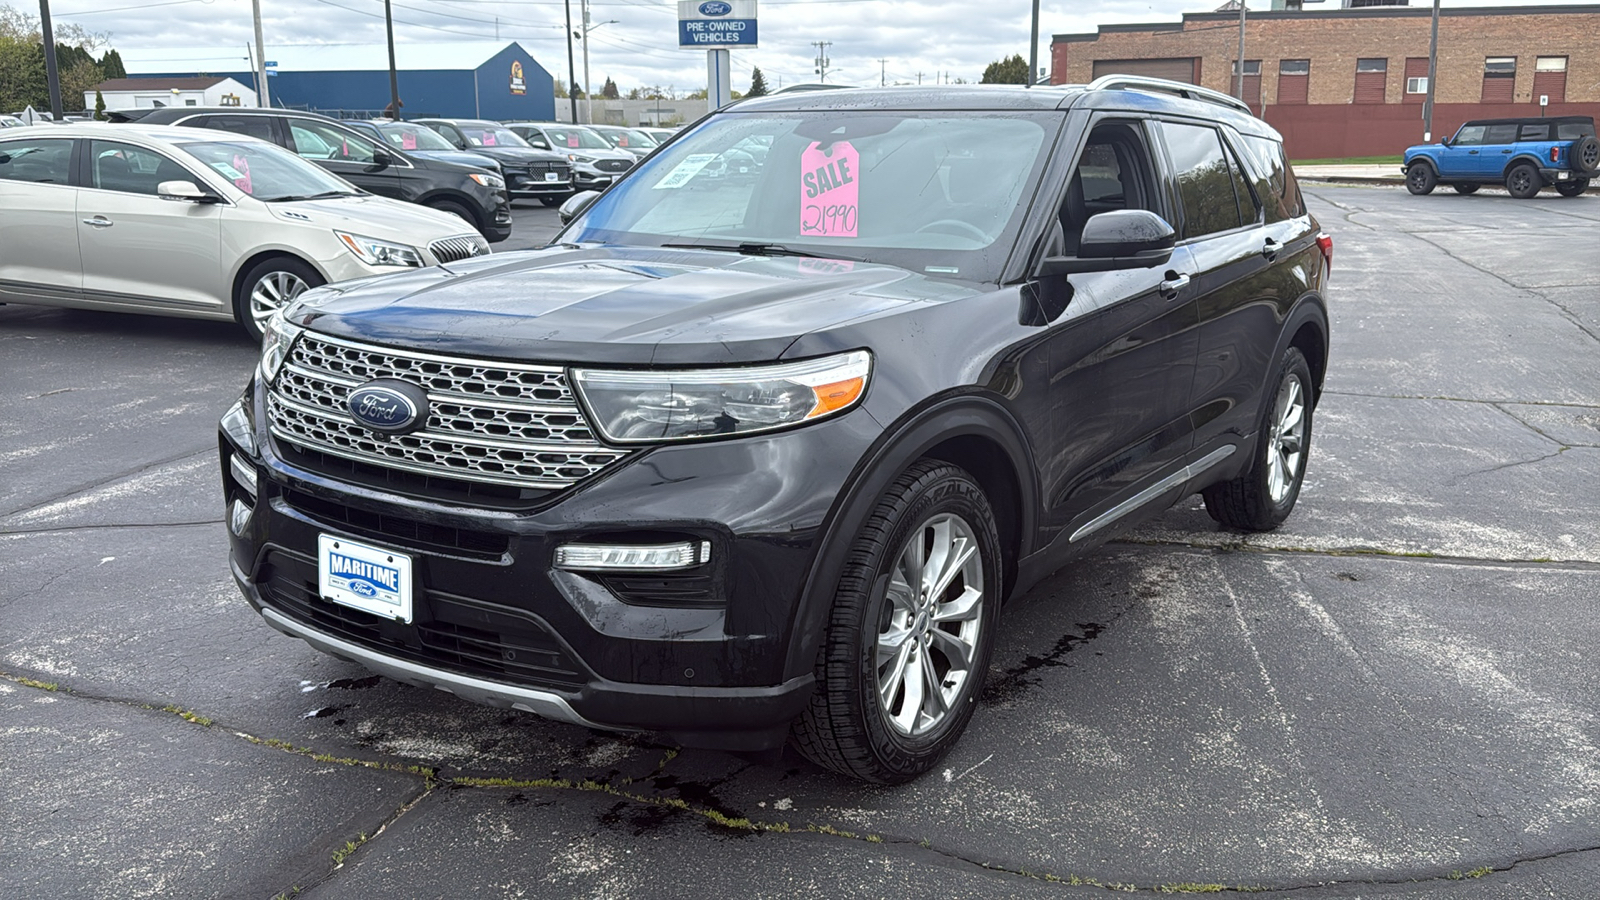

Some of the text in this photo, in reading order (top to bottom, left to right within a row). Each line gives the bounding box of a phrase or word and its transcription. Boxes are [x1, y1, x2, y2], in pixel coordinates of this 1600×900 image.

[705, 3, 724, 13] Ford
[693, 32, 739, 42] VEHICLES
[803, 157, 853, 199] SALE
[802, 204, 857, 235] $21,990
[359, 394, 397, 420] Ford
[331, 554, 397, 591] MARITIME
[353, 581, 372, 595] Ford
